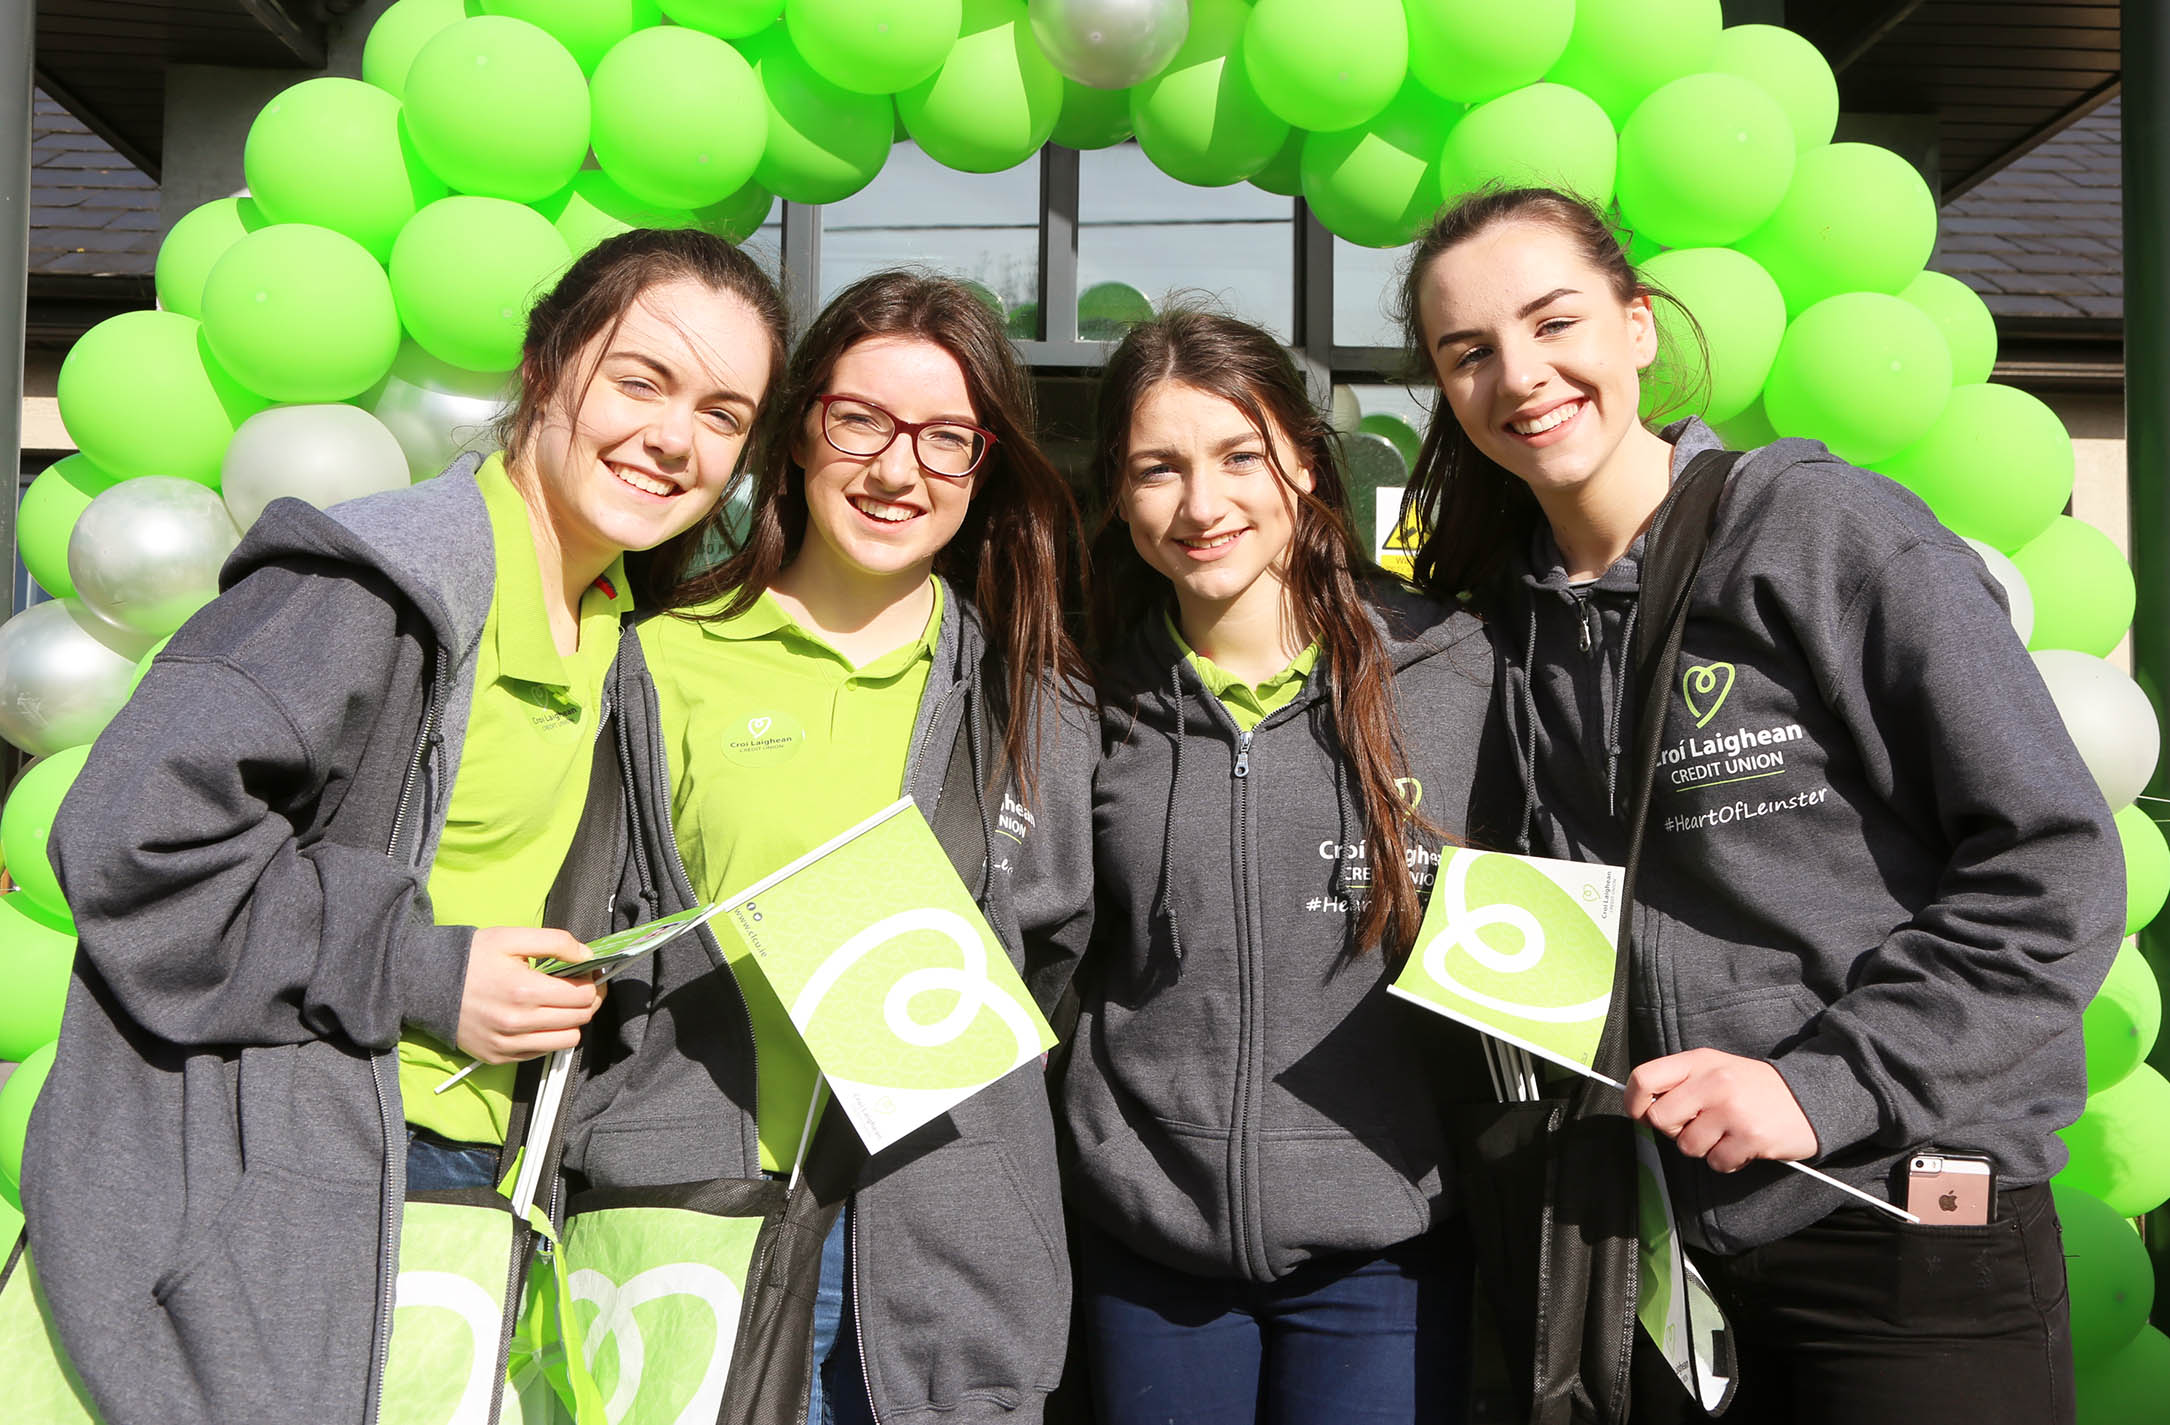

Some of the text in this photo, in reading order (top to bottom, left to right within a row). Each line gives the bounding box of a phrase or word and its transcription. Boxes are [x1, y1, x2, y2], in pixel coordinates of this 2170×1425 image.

[751, 736, 793, 746] Laighean
[1656, 723, 1803, 767] roí Laighean
[1671, 751, 1784, 785] CREDIT UNION
[999, 814, 1027, 838] NION
[1664, 788, 1828, 833] #HeartOfLeinster
[1318, 840, 1367, 860] Croí
[1603, 870, 1612, 904] Laighean
[735, 908, 768, 958] www.clcu.ie
